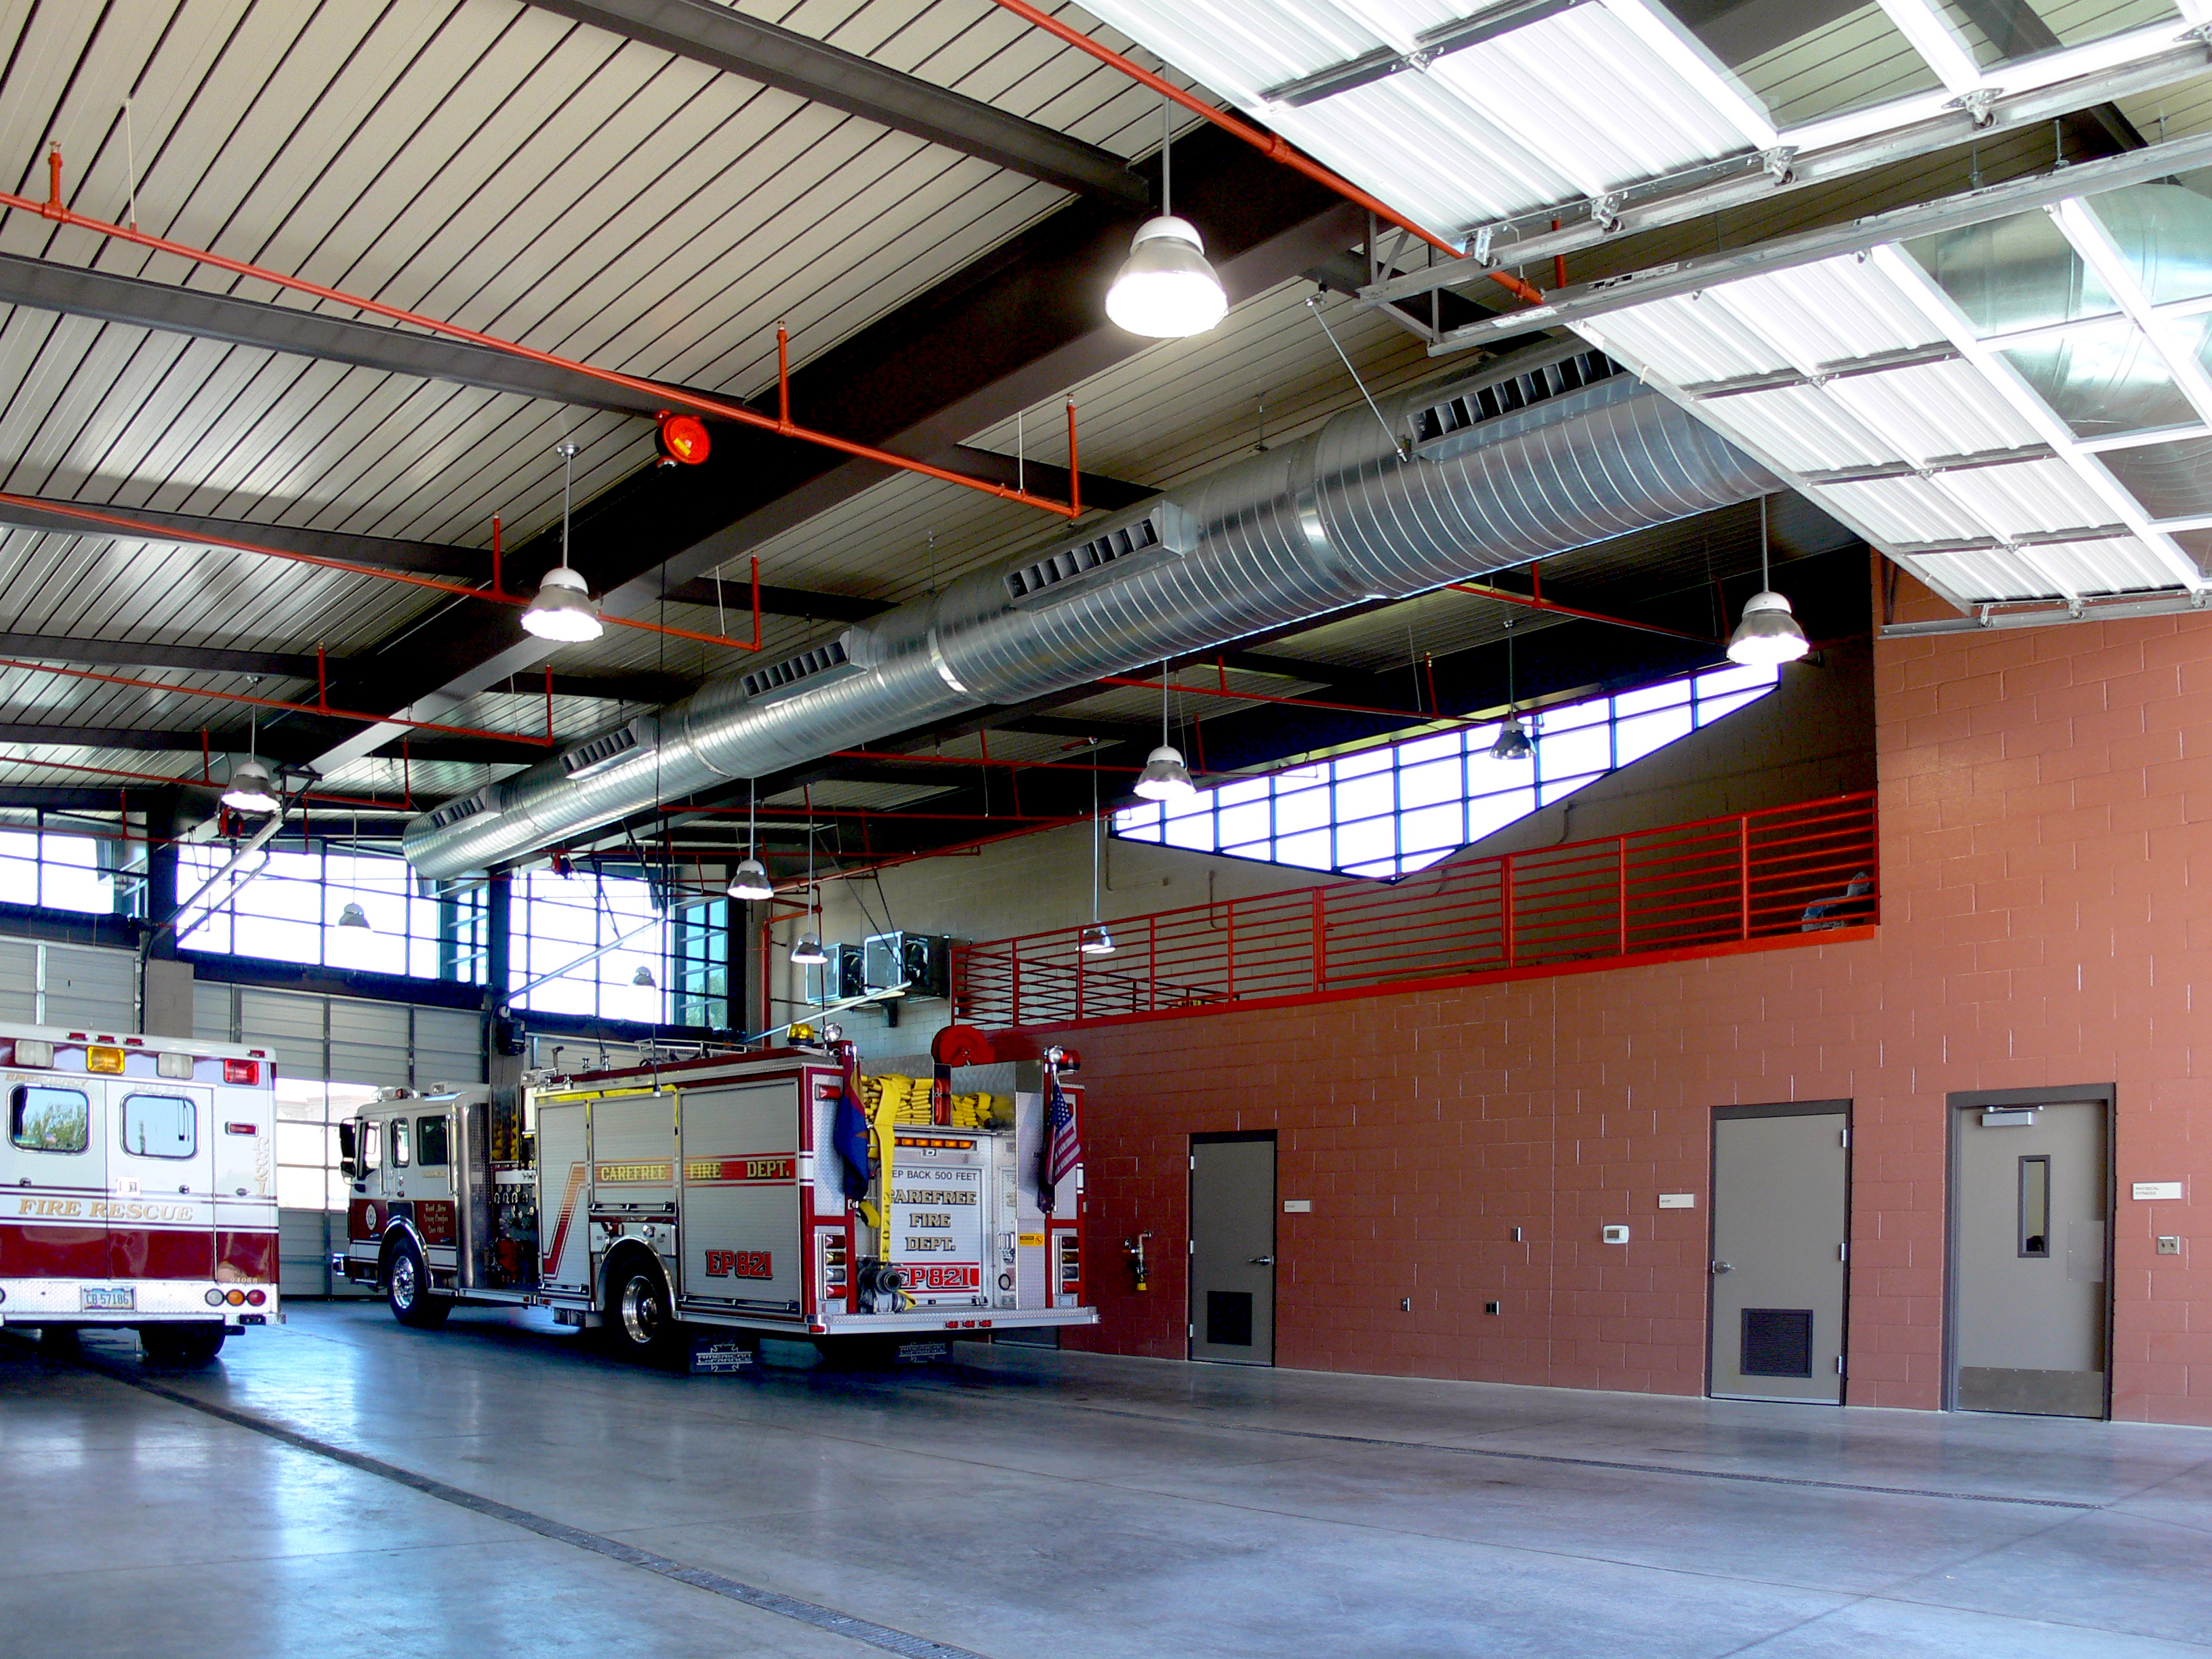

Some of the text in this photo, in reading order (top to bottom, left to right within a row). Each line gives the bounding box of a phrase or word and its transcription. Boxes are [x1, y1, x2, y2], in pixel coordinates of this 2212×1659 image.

[601, 1160, 790, 1181] CAREFREE FIRE DEPT.
[892, 1170, 977, 1181] EP BACK 500 FEET
[18, 1198, 194, 1221] FIRE RESCUE
[909, 1213, 951, 1228] FIRE
[905, 1236, 956, 1252] DEPT.
[705, 1249, 774, 1280] EP821
